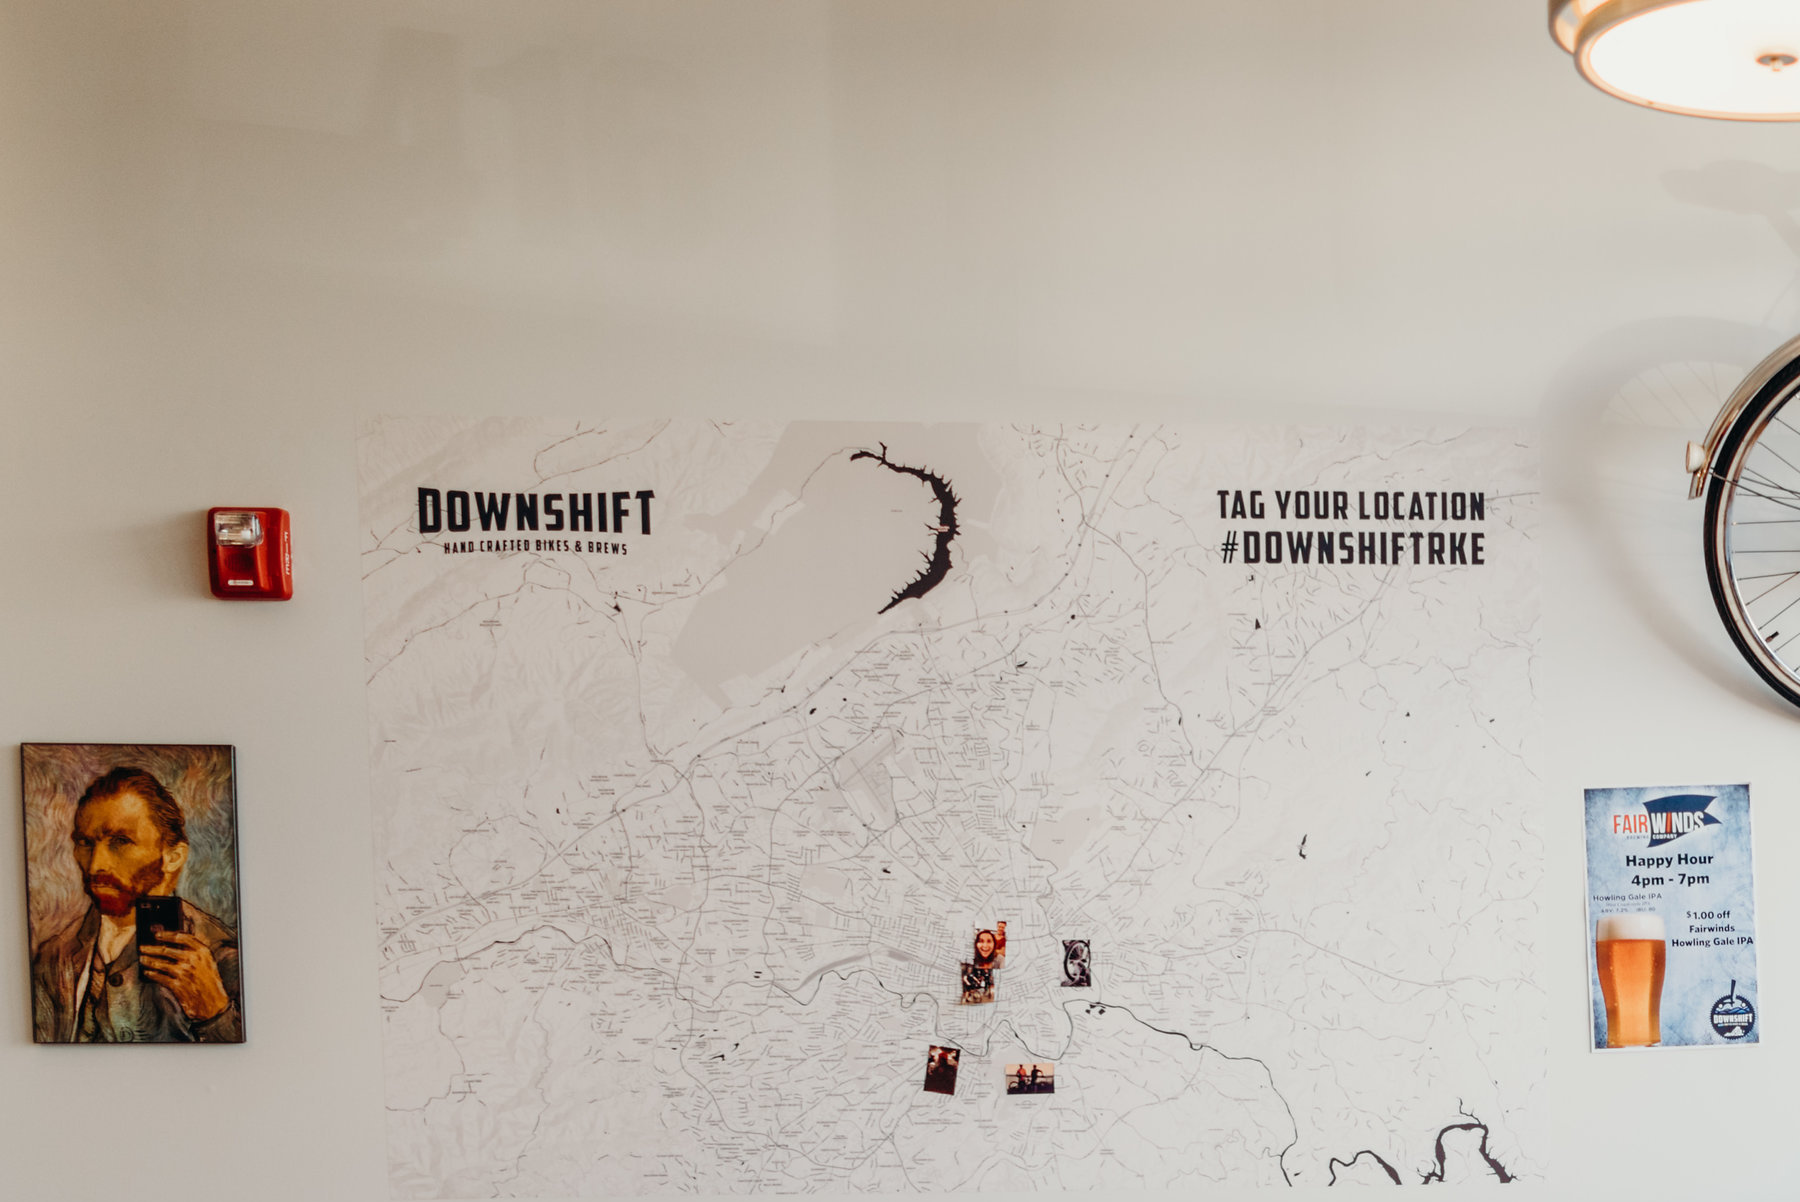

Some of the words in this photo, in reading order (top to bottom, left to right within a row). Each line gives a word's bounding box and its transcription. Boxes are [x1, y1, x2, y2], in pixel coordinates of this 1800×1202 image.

[417, 487, 655, 535] DOWNSHIFT
[1217, 490, 1265, 519] TAG
[1275, 490, 1348, 520] YOUR
[1359, 491, 1485, 521] LOCATION
[444, 541, 475, 555] HAND
[480, 539, 530, 553] CRAFTED
[536, 539, 570, 552] BIKES
[575, 541, 582, 552] &
[588, 541, 628, 556] BREWS
[1221, 530, 1485, 565] #DOWNSHIFTRKE
[1625, 855, 1673, 869] Happy
[1677, 853, 1714, 865] Hour
[1631, 875, 1665, 888] 4pm
[1678, 873, 1710, 887] 7pm
[1593, 894, 1626, 902] Howling
[1686, 910, 1715, 920] $1.00
[1717, 910, 1731, 919] off
[1689, 924, 1735, 933] Fairwinds
[1671, 938, 1711, 948] Howling
[1713, 937, 1735, 946] Gale
[1737, 936, 1754, 945] IPA
